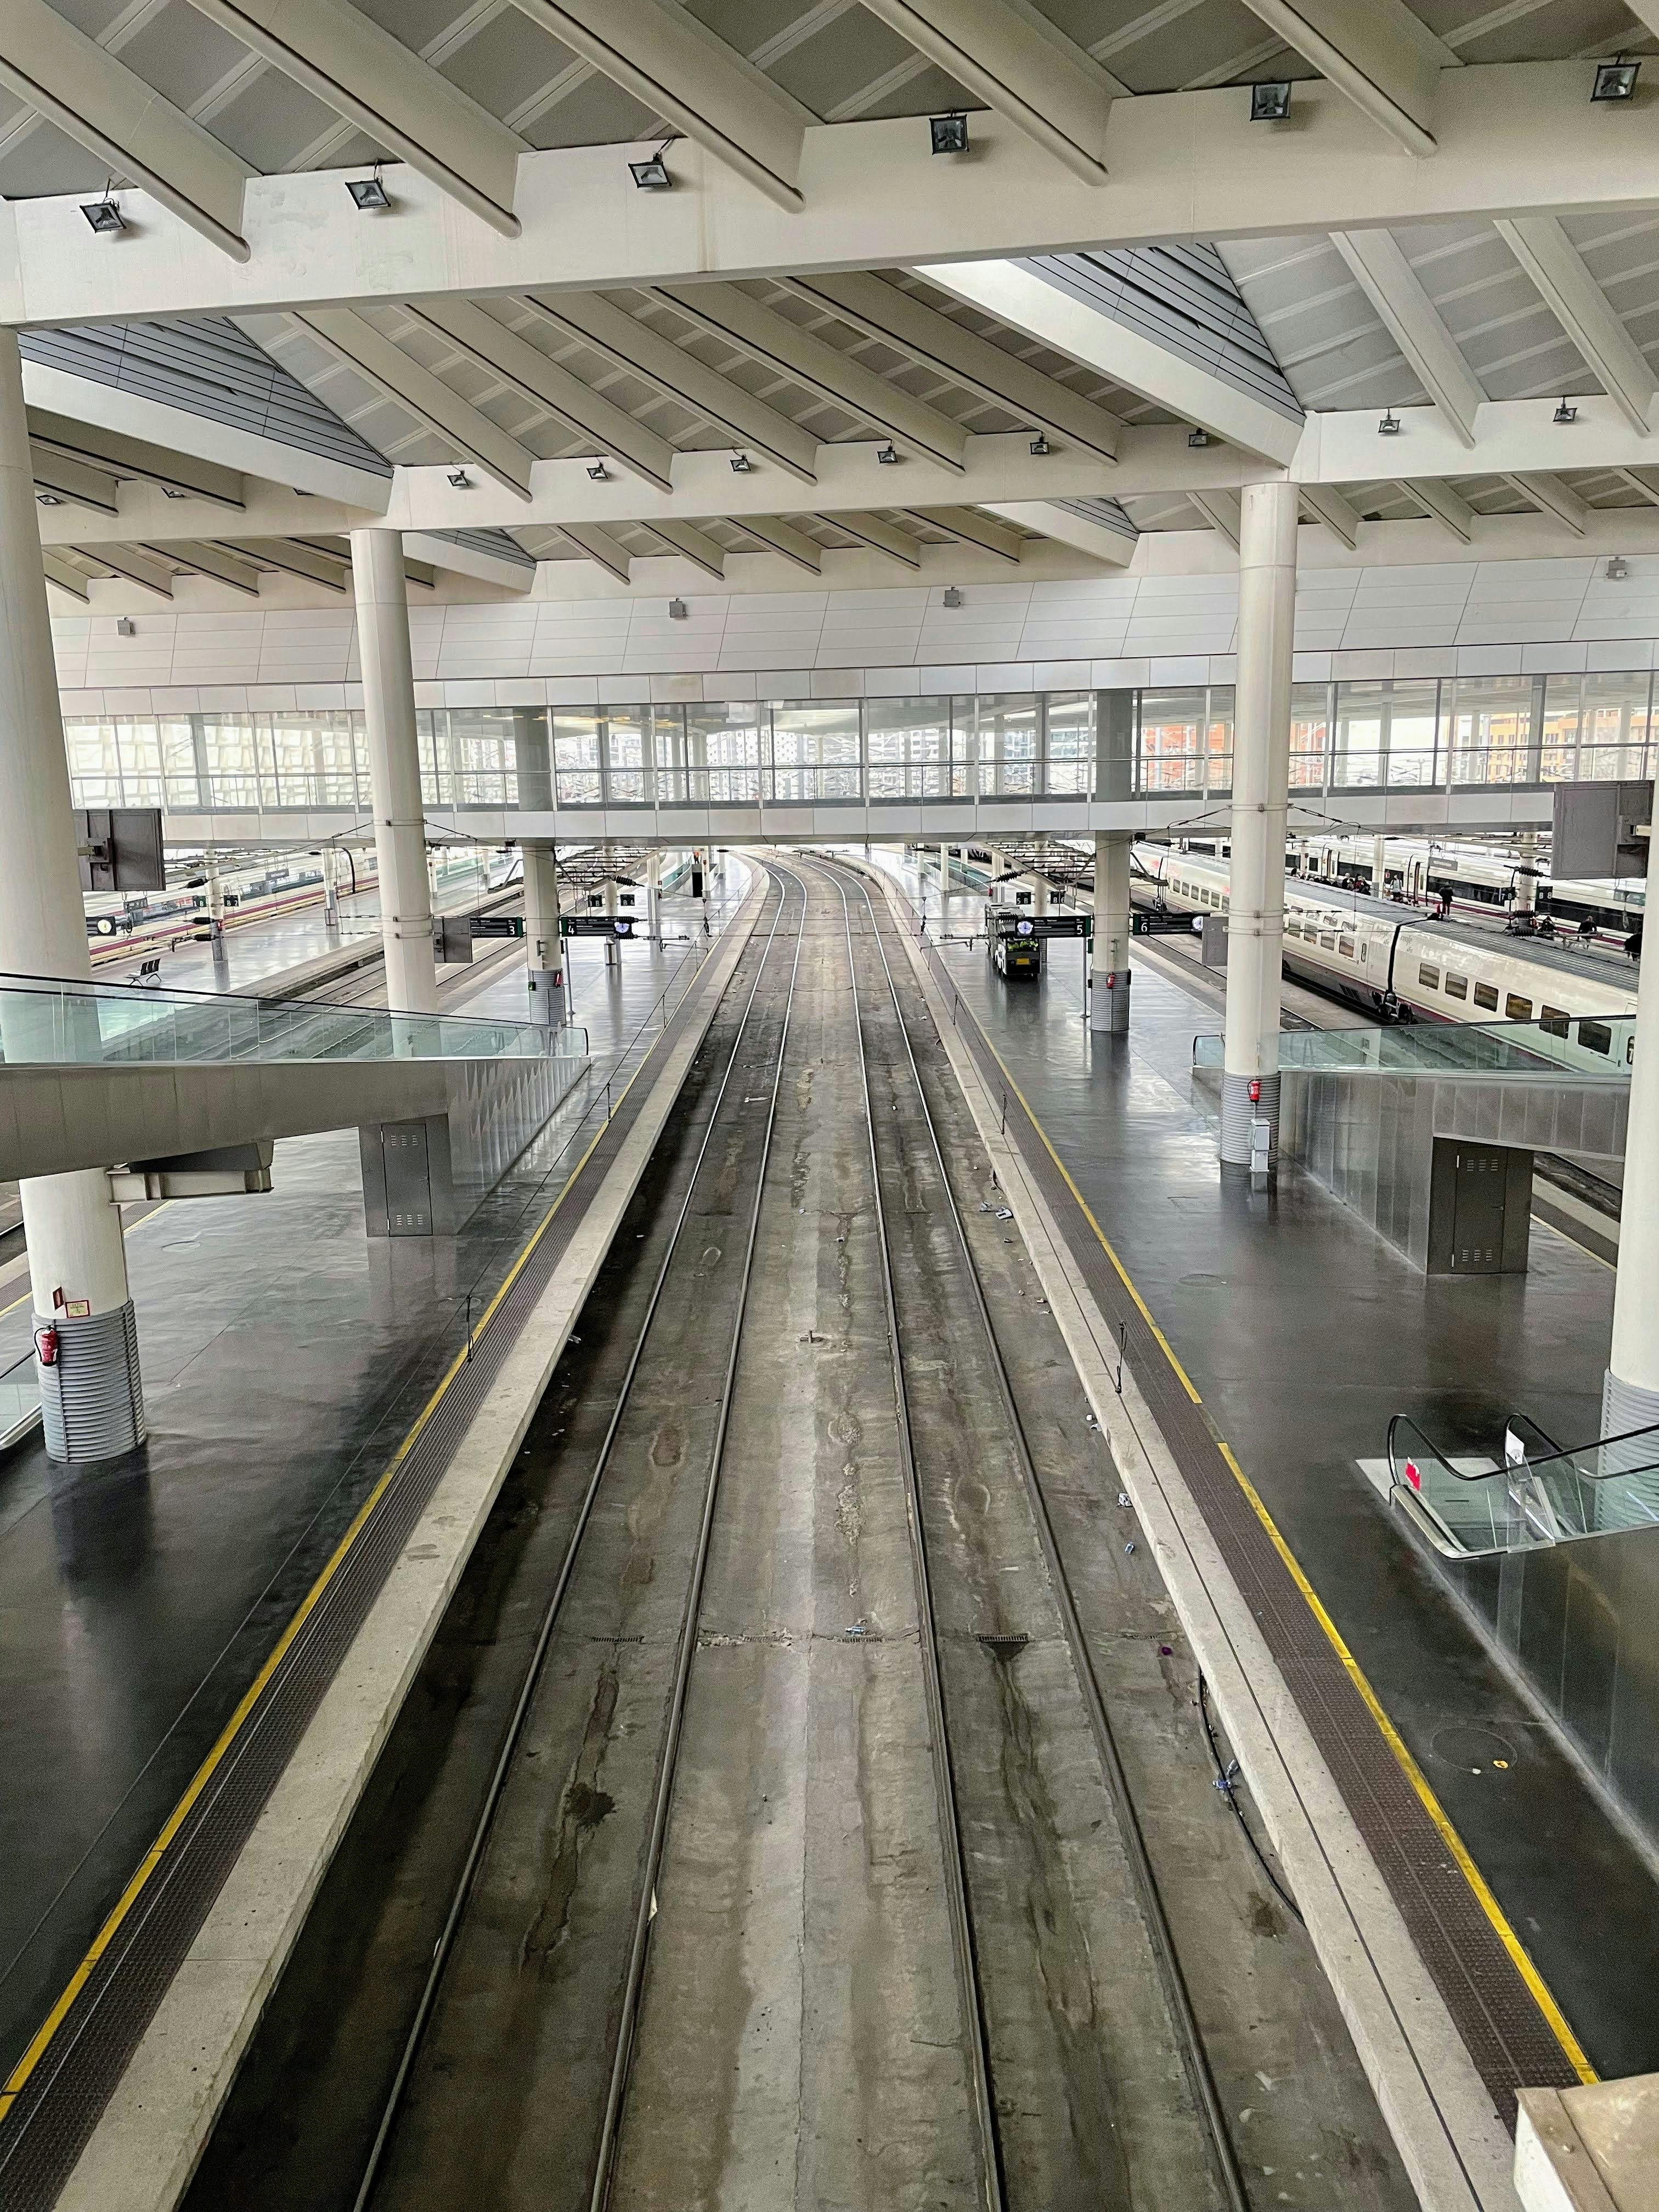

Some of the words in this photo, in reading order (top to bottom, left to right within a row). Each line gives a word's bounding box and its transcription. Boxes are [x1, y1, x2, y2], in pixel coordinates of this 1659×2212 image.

[509, 926, 515, 935] 3
[568, 925, 574, 935] 4
[1076, 924, 1083, 935] 5
[1141, 922, 1148, 932] 6
